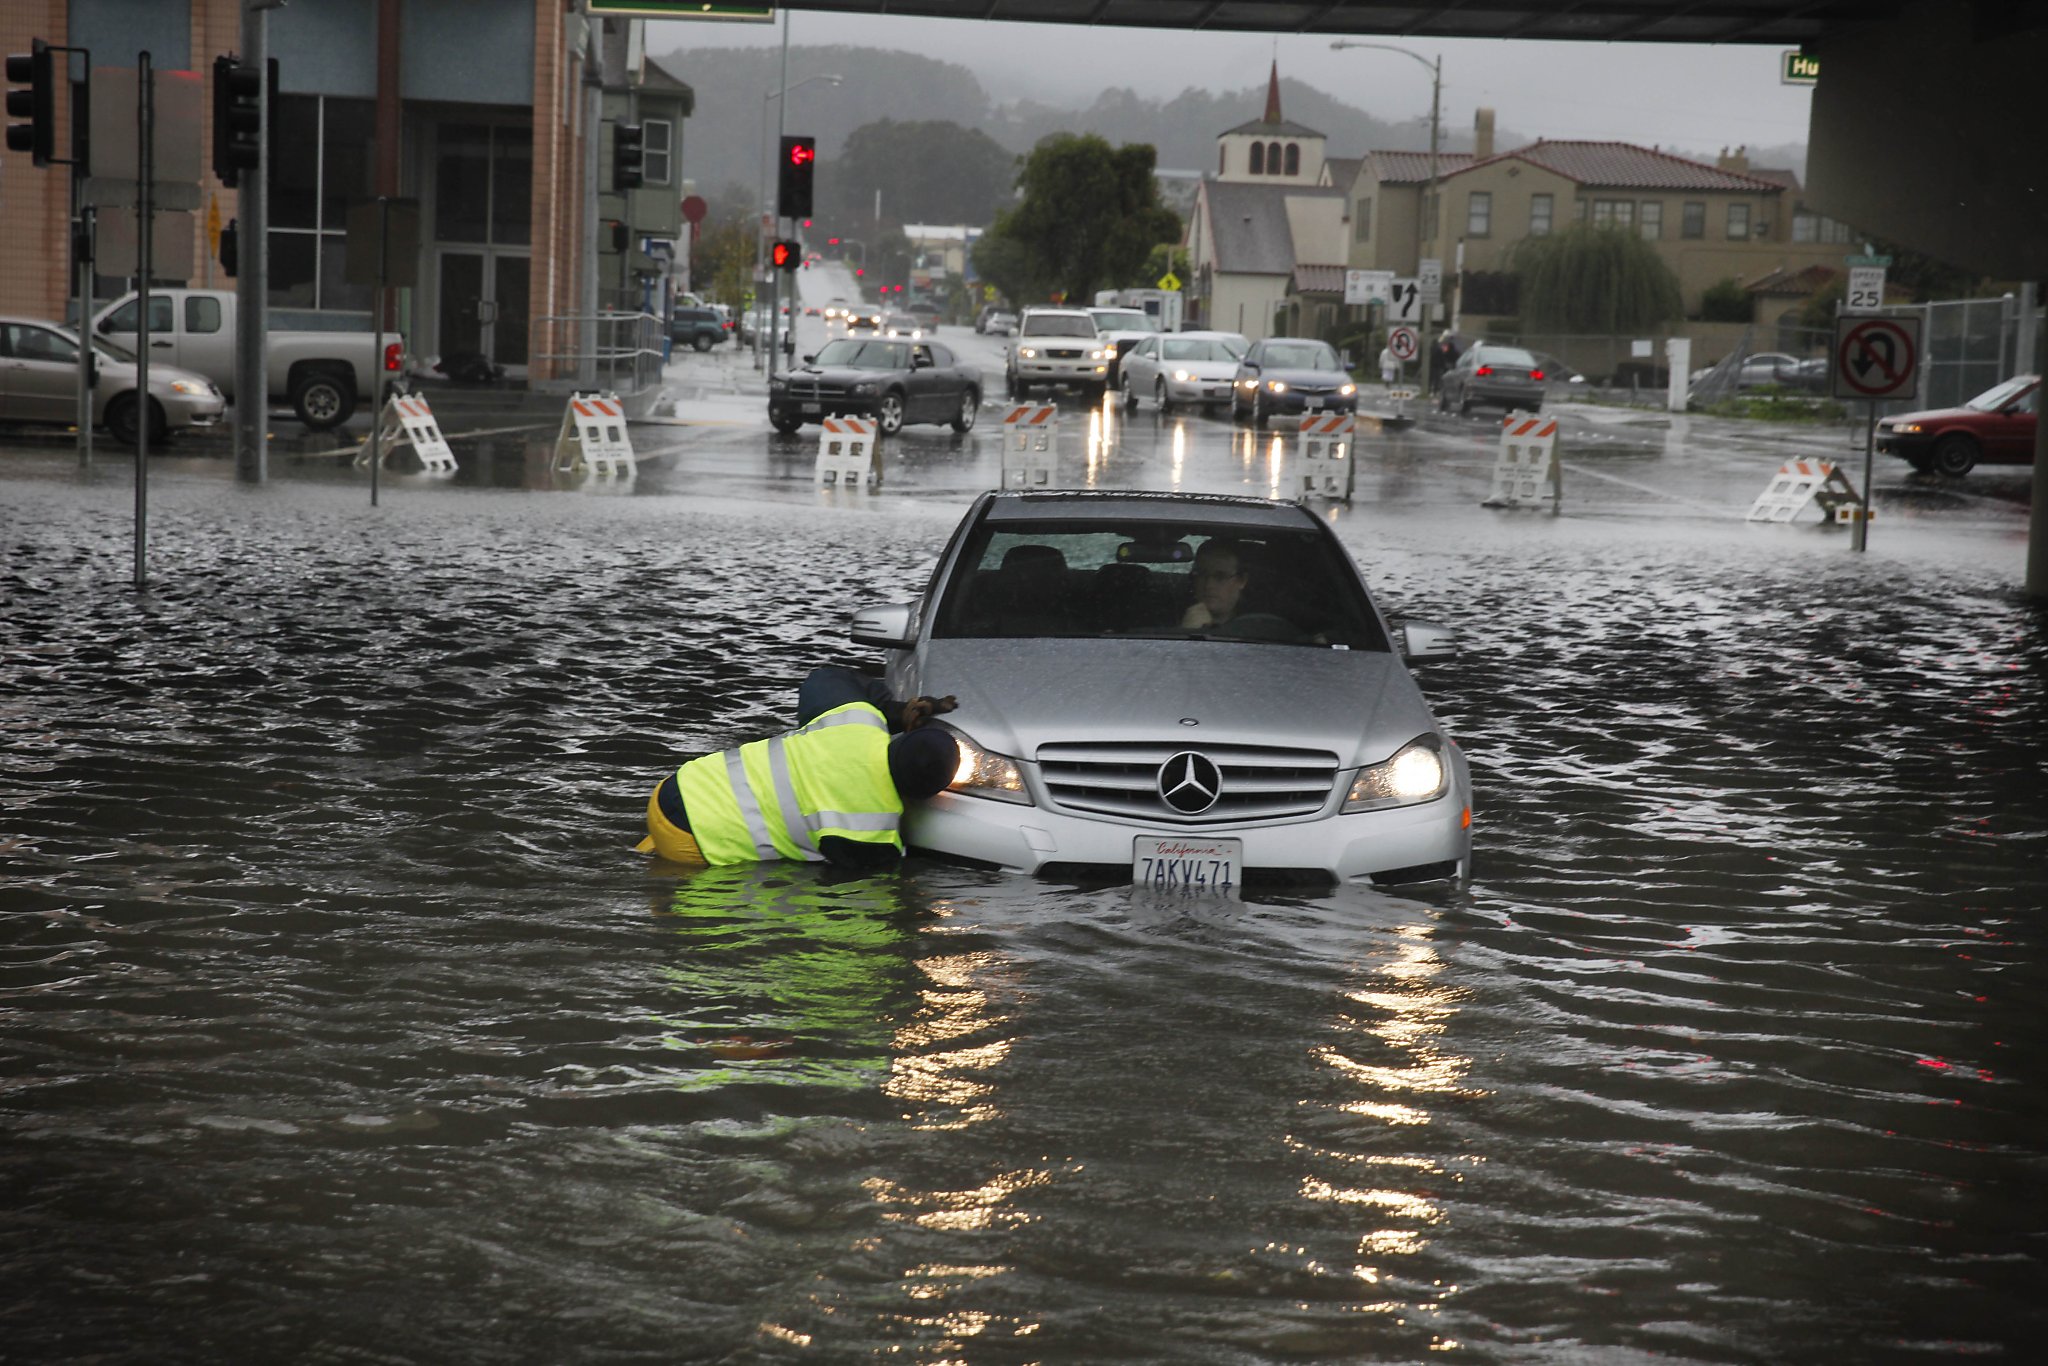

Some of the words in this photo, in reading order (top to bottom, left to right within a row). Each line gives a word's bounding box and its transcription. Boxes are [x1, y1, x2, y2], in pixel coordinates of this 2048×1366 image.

[1851, 291, 1879, 307] 25
[1156, 842, 1222, 858] California
[1142, 858, 1232, 885] 7AKV471
